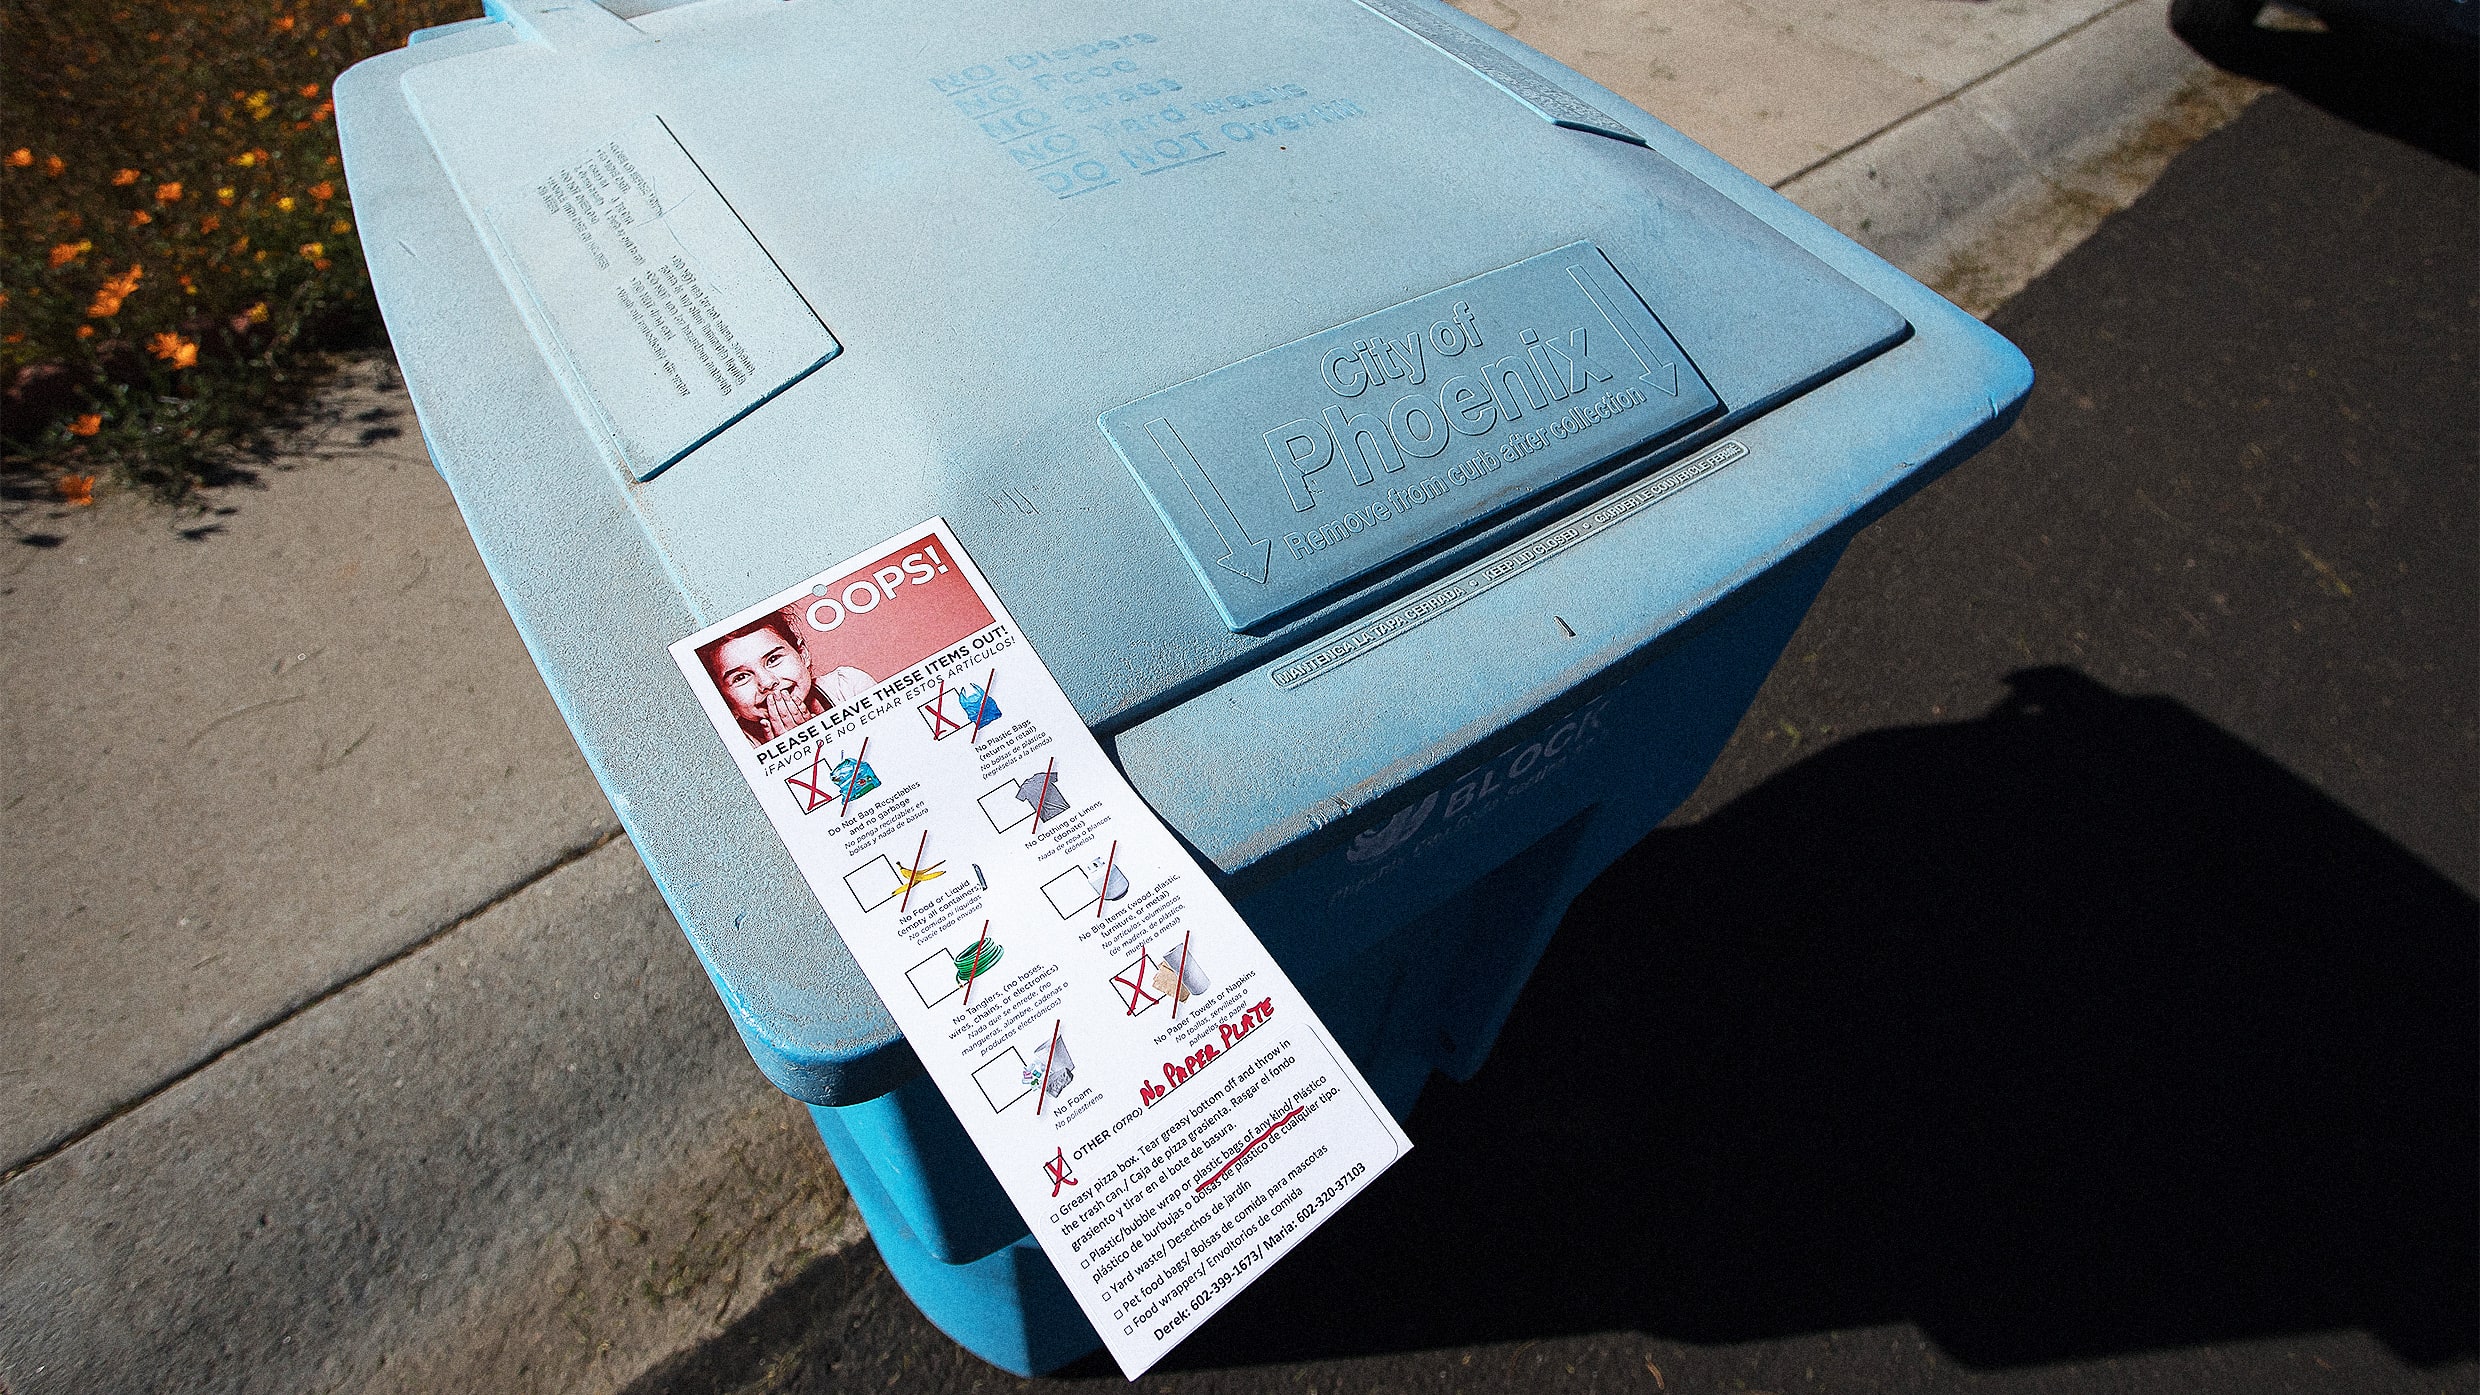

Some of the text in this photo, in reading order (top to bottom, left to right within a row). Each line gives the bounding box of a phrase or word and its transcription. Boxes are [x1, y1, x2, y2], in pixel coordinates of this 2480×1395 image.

[929, 64, 996, 92] NO
[954, 85, 1023, 116] NO
[979, 108, 1049, 139] NO
[1009, 134, 1077, 166] NO
[1038, 160, 1109, 194] DO
[1119, 131, 1210, 168] NOT
[1320, 301, 1484, 397] City of
[1262, 327, 1614, 513] Phoenix
[1283, 386, 1648, 561] Remove from curb after collection
[1594, 496, 1641, 524] GARDER
[1636, 489, 1654, 503] LE
[805, 545, 949, 632] OOPS!
[1482, 527, 1579, 581] KEEP LID CLOSED
[1276, 586, 1467, 685] MANTENGA LA TAPA CERRADA
[756, 624, 1008, 765] PLEASE LEAVE THESE ITEMS OUT!
[764, 635, 1015, 776] ¡FAVOR DE NO ECHAR ESTOS ARTÍCULOS!
[974, 719, 1031, 753] No Plastic Bags
[1443, 701, 1610, 819] BLOCK
[827, 781, 920, 836] Do Not Bag Recyclables
[1024, 840, 1037, 849] No
[1037, 820, 1069, 841] Clothing
[1077, 800, 1102, 817] Linens
[899, 879, 970, 924] No Food or Liquid
[1078, 874, 1180, 941] No Big Items (wood, plastic,
[948, 964, 1058, 1039] wires, chains, or electronics)
[952, 964, 1044, 1025] No Tanglers, (no hoses,
[1153, 970, 1255, 1045] No Paper Towels or Napkins
[1162, 1044, 1219, 1088] PAPER
[1218, 997, 1275, 1048] PLATE
[1053, 1087, 1092, 1117] No Foam
[1059, 1039, 1290, 1215] Greasy pizza box. Tear greasy bottom off and throw in
[1060, 1056, 1295, 1235] the trash can./ Caja de pizza grasienta. Rasgar el fondo
[1072, 1106, 1142, 1160] OTHER (OTRO)
[1071, 1123, 1236, 1252] grasiento y tirar en el bote de basura.
[1088, 1075, 1326, 1262] Plastic/bubble wrap or plastic bags of any kind/ Plástico
[1092, 1087, 1340, 1284] plástico de burbujas o bolsas de de cualquier tipo.
[1109, 1180, 1251, 1293] Yard waste/ Desechos de jardín
[1122, 1144, 1328, 1312] Pet food bags/ Bolsas de comida para mascotas
[1132, 1187, 1303, 1327] Food wrappers/ Envoltorios de comida
[1153, 1162, 1365, 1341] Derek: 602-399-1673/ Maria: 602-320-37103
